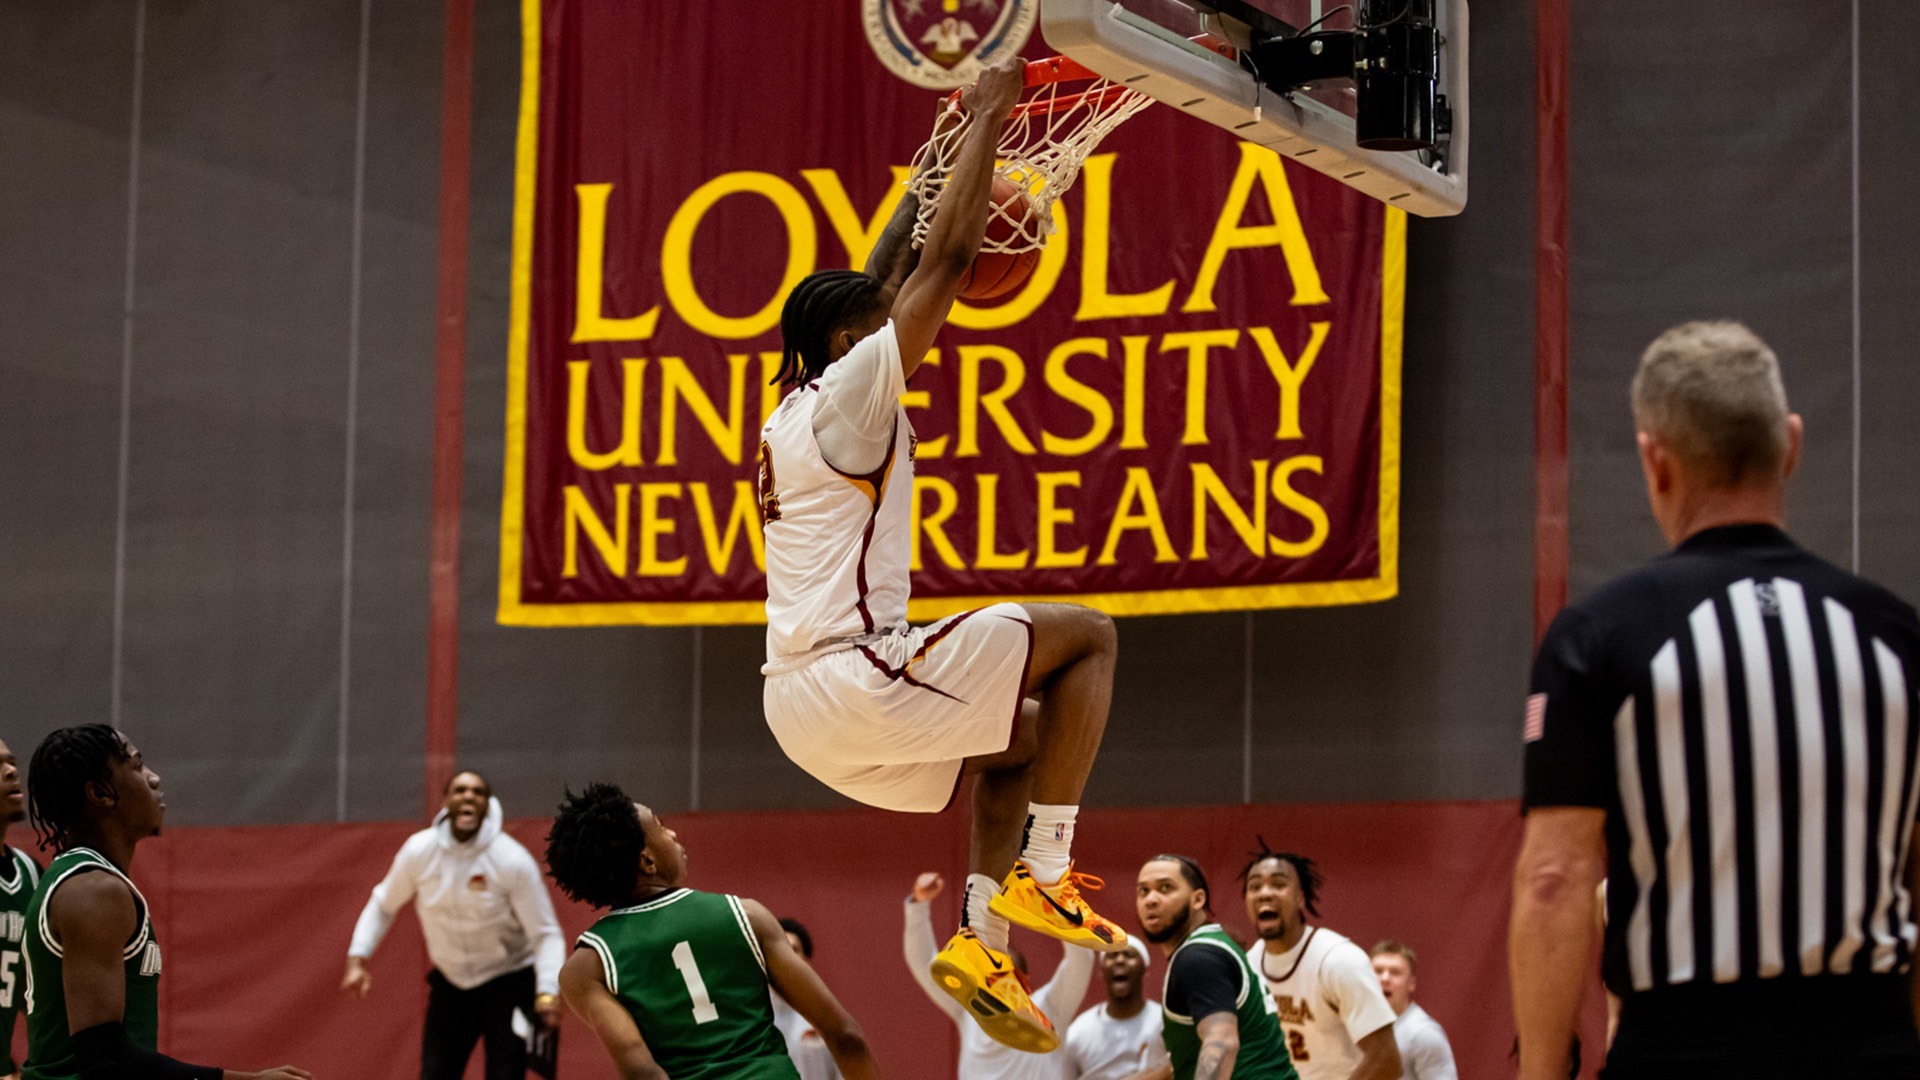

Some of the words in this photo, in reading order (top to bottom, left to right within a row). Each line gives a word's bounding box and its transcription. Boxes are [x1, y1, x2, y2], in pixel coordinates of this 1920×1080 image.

[566, 322, 1332, 471] UNIERSITY
[561, 481, 767, 579] NEW
[910, 455, 1330, 571] RLEANS
[671, 940, 719, 1025] 1
